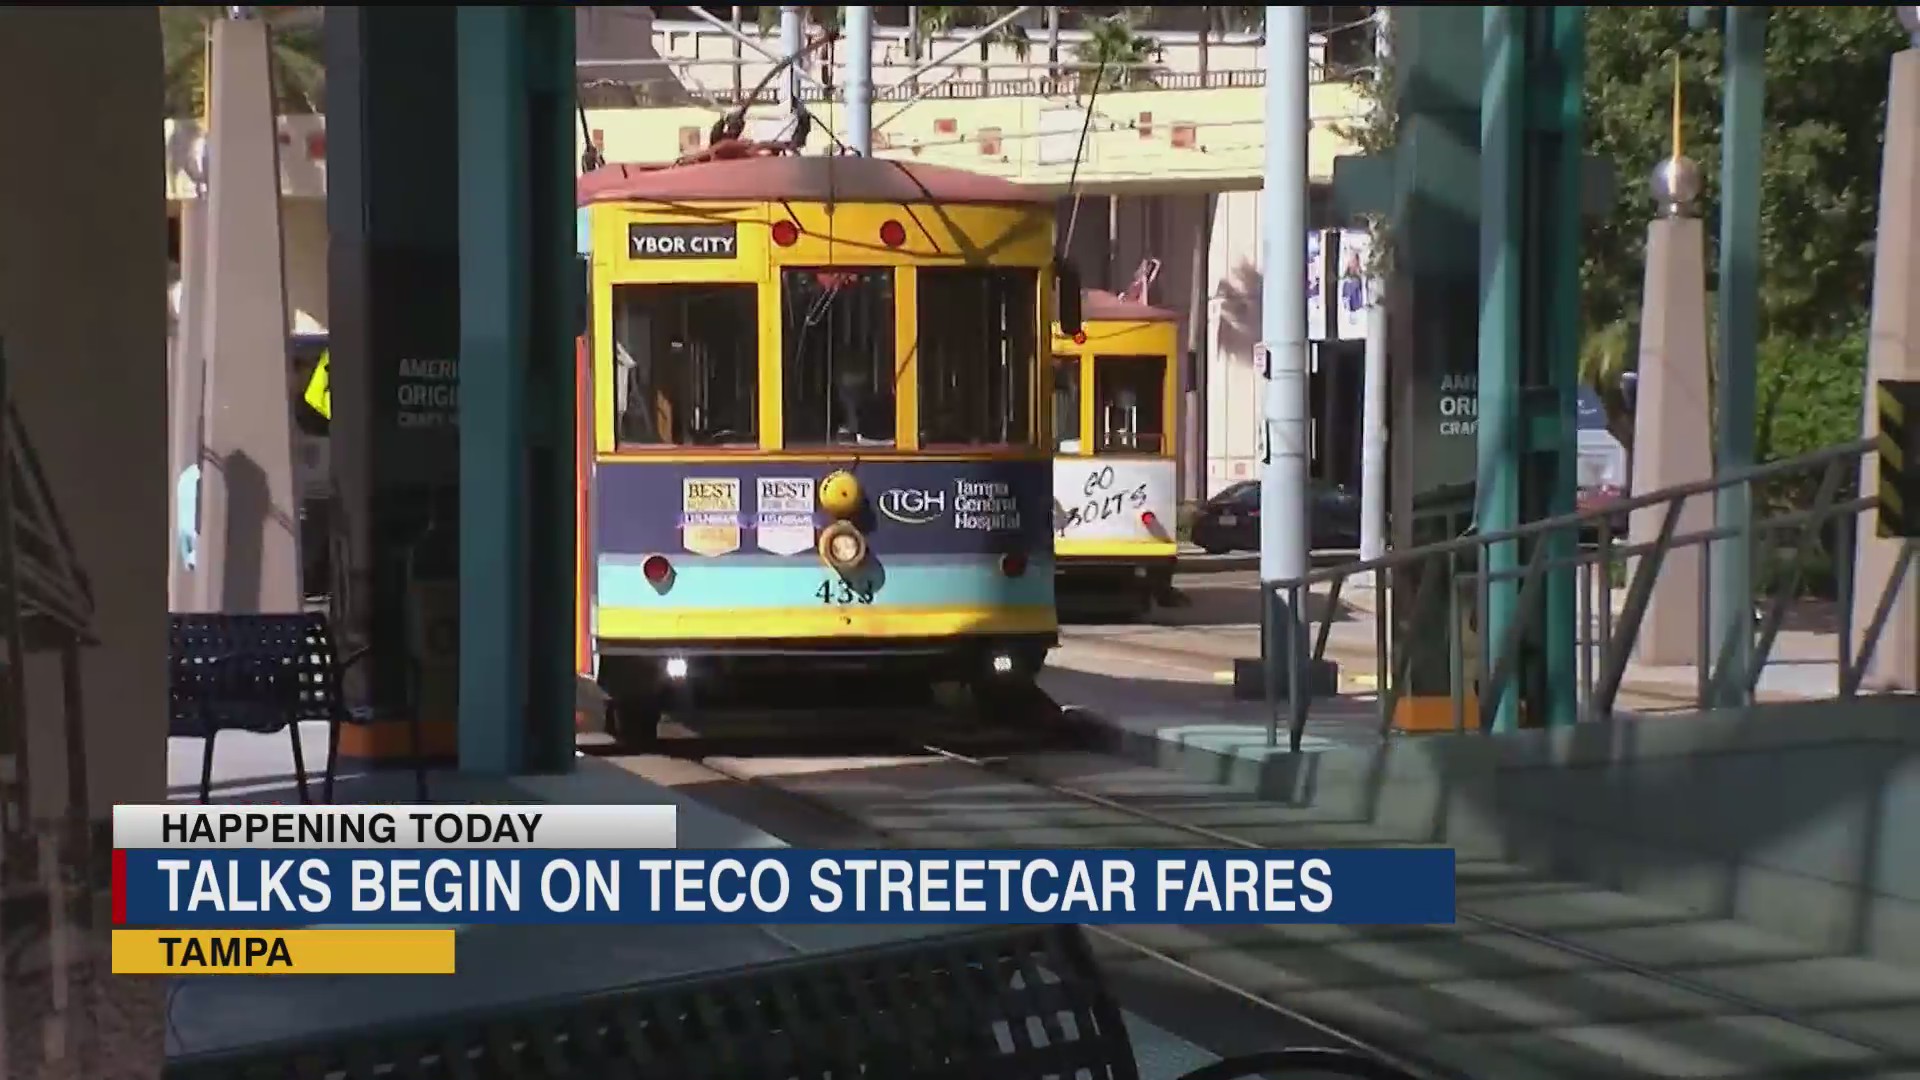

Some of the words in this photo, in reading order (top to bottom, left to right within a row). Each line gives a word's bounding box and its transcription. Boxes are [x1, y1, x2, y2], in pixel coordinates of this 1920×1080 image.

[632, 236, 686, 253] YBOR
[690, 236, 735, 253] CITY
[398, 384, 456, 406] ORIGI
[1440, 396, 1477, 416] ORI
[687, 482, 736, 499] BEST
[761, 482, 811, 499] BEST
[954, 478, 1009, 496] Tampa
[1084, 465, 1115, 497] GO
[888, 489, 945, 512] TGH
[954, 495, 1017, 512] General
[954, 511, 1021, 531] Hospital
